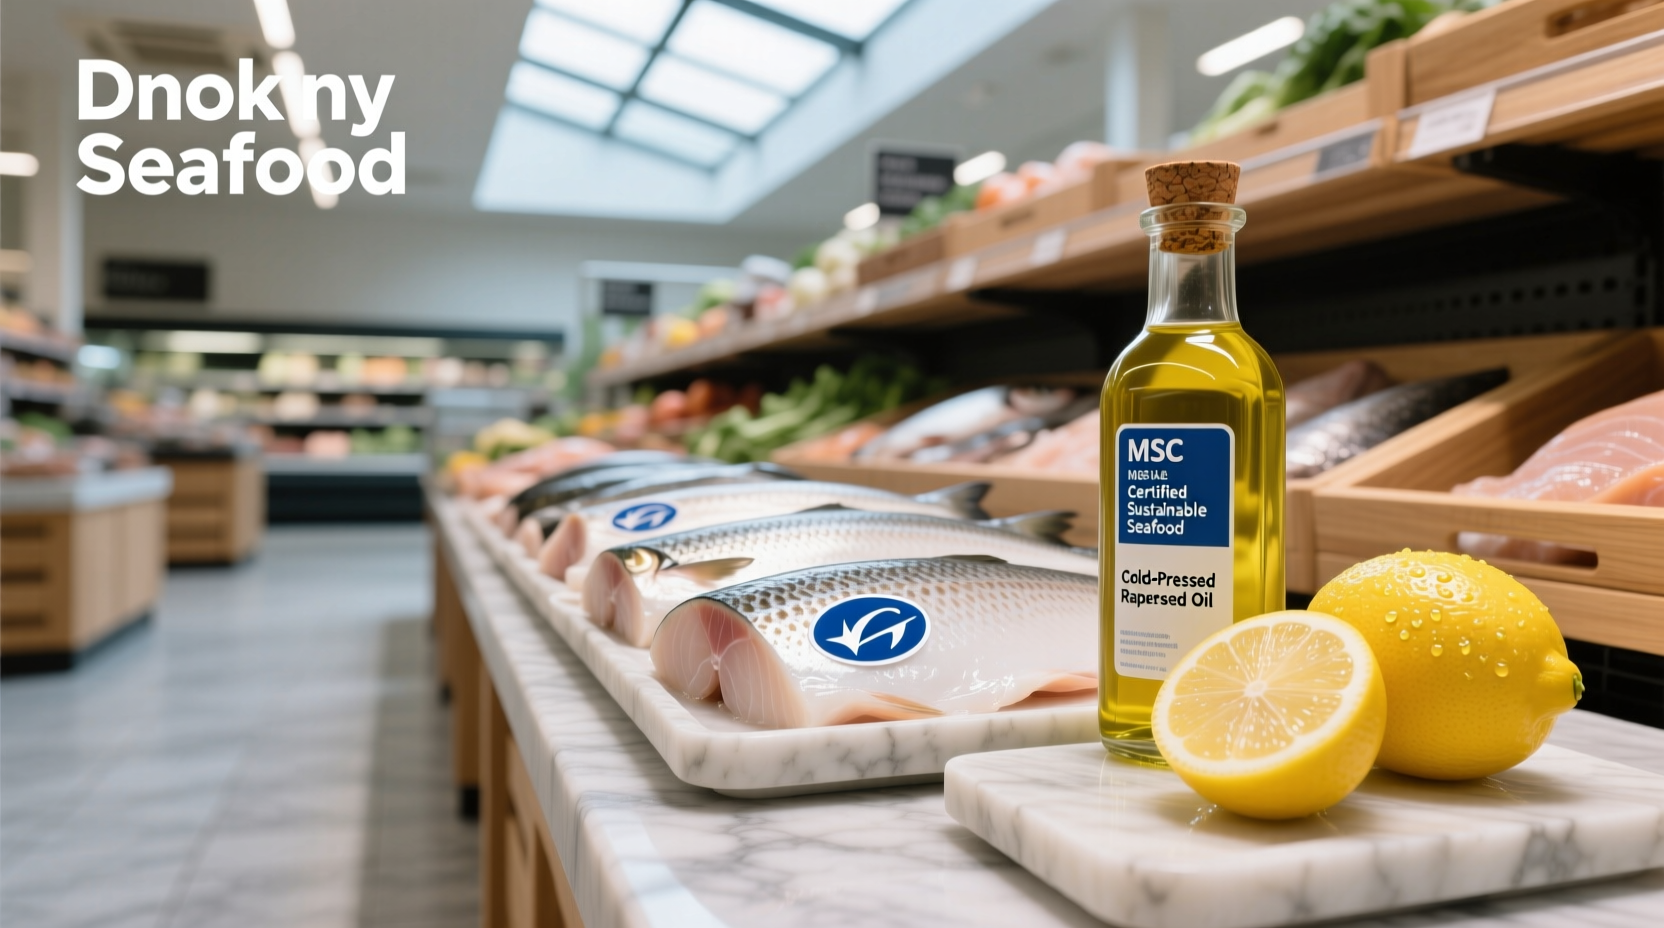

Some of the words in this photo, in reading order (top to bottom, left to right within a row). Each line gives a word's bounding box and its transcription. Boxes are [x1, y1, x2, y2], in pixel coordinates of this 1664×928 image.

[1127, 438, 1184, 463] MSC
[1127, 484, 1188, 499] Certified
[1127, 501, 1208, 518] Sustainable
[1127, 518, 1185, 535] Seafood
[1121, 569, 1216, 588] Cold-Pressed
[1121, 588, 1187, 608] Rapersed
[1191, 591, 1213, 608] Oil
